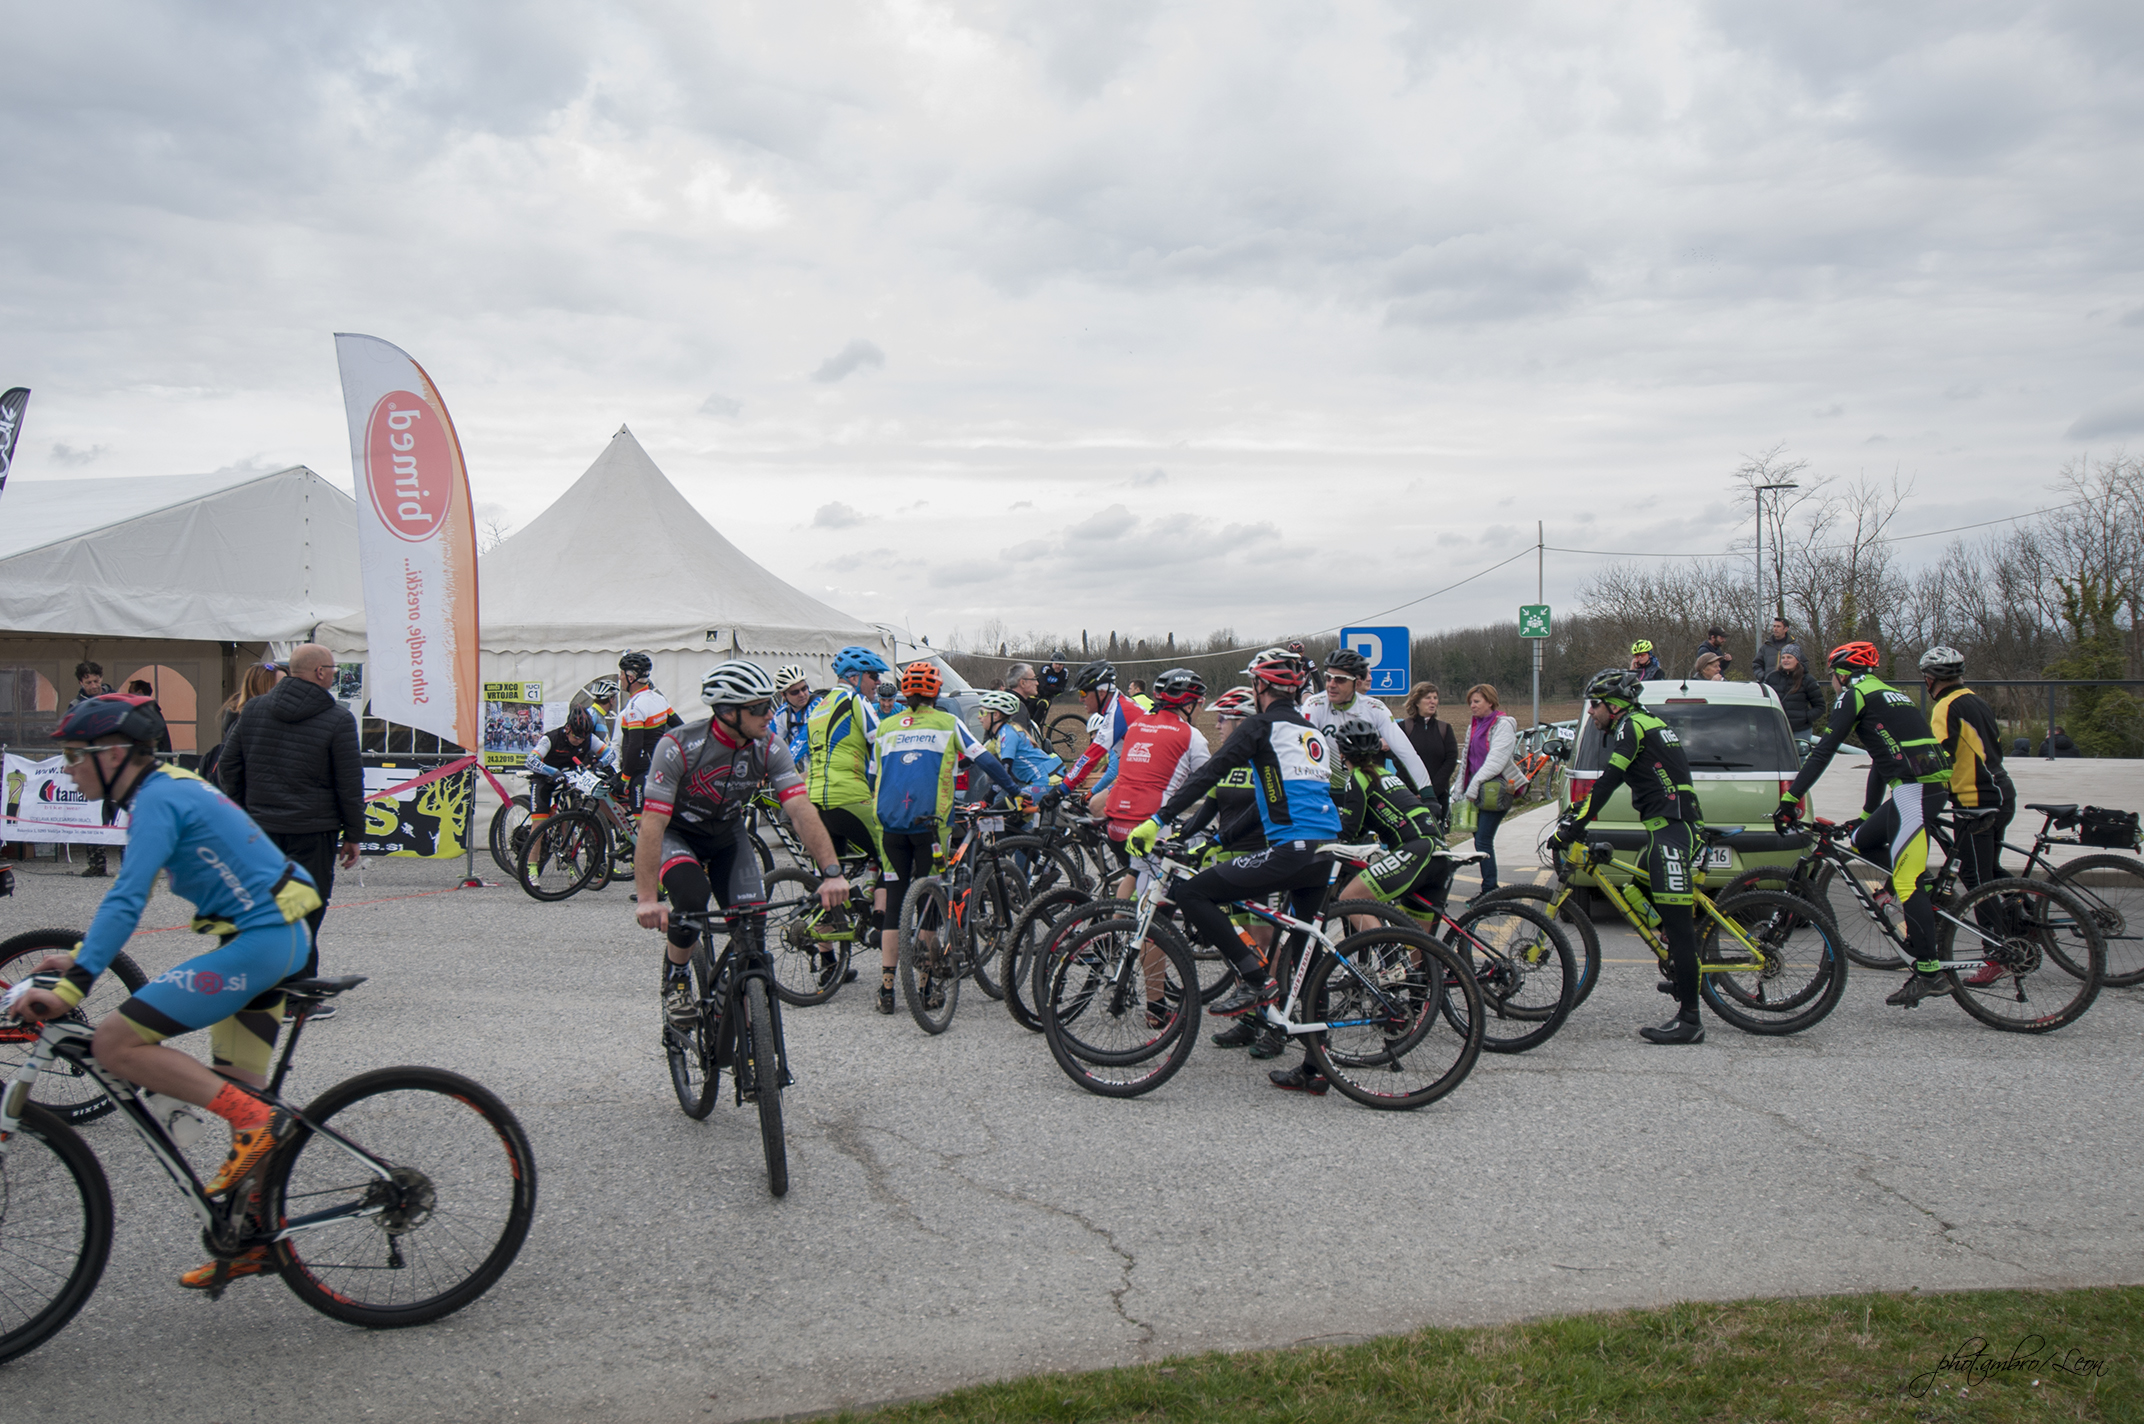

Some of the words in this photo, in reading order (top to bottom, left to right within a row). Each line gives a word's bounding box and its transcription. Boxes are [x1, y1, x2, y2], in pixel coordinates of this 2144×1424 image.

[1347, 633, 1382, 668] P
[503, 683, 518, 691] XCO
[528, 690, 538, 699] C1
[487, 691, 518, 700] VRTOJBA
[897, 734, 937, 744] Element
[34, 765, 65, 776] www.t
[579, 775, 595, 789] 304
[939, 761, 953, 814] GUARRERA
[56, 786, 88, 802] tama
[1369, 850, 1413, 877] MBC
[1376, 854, 1418, 881] TRIESTE
[1663, 845, 1685, 892] MBC
[197, 847, 255, 911] ORBEA
[2024, 1015, 2064, 1029] MAXXIS
[72, 1097, 111, 1117] AXXIS
